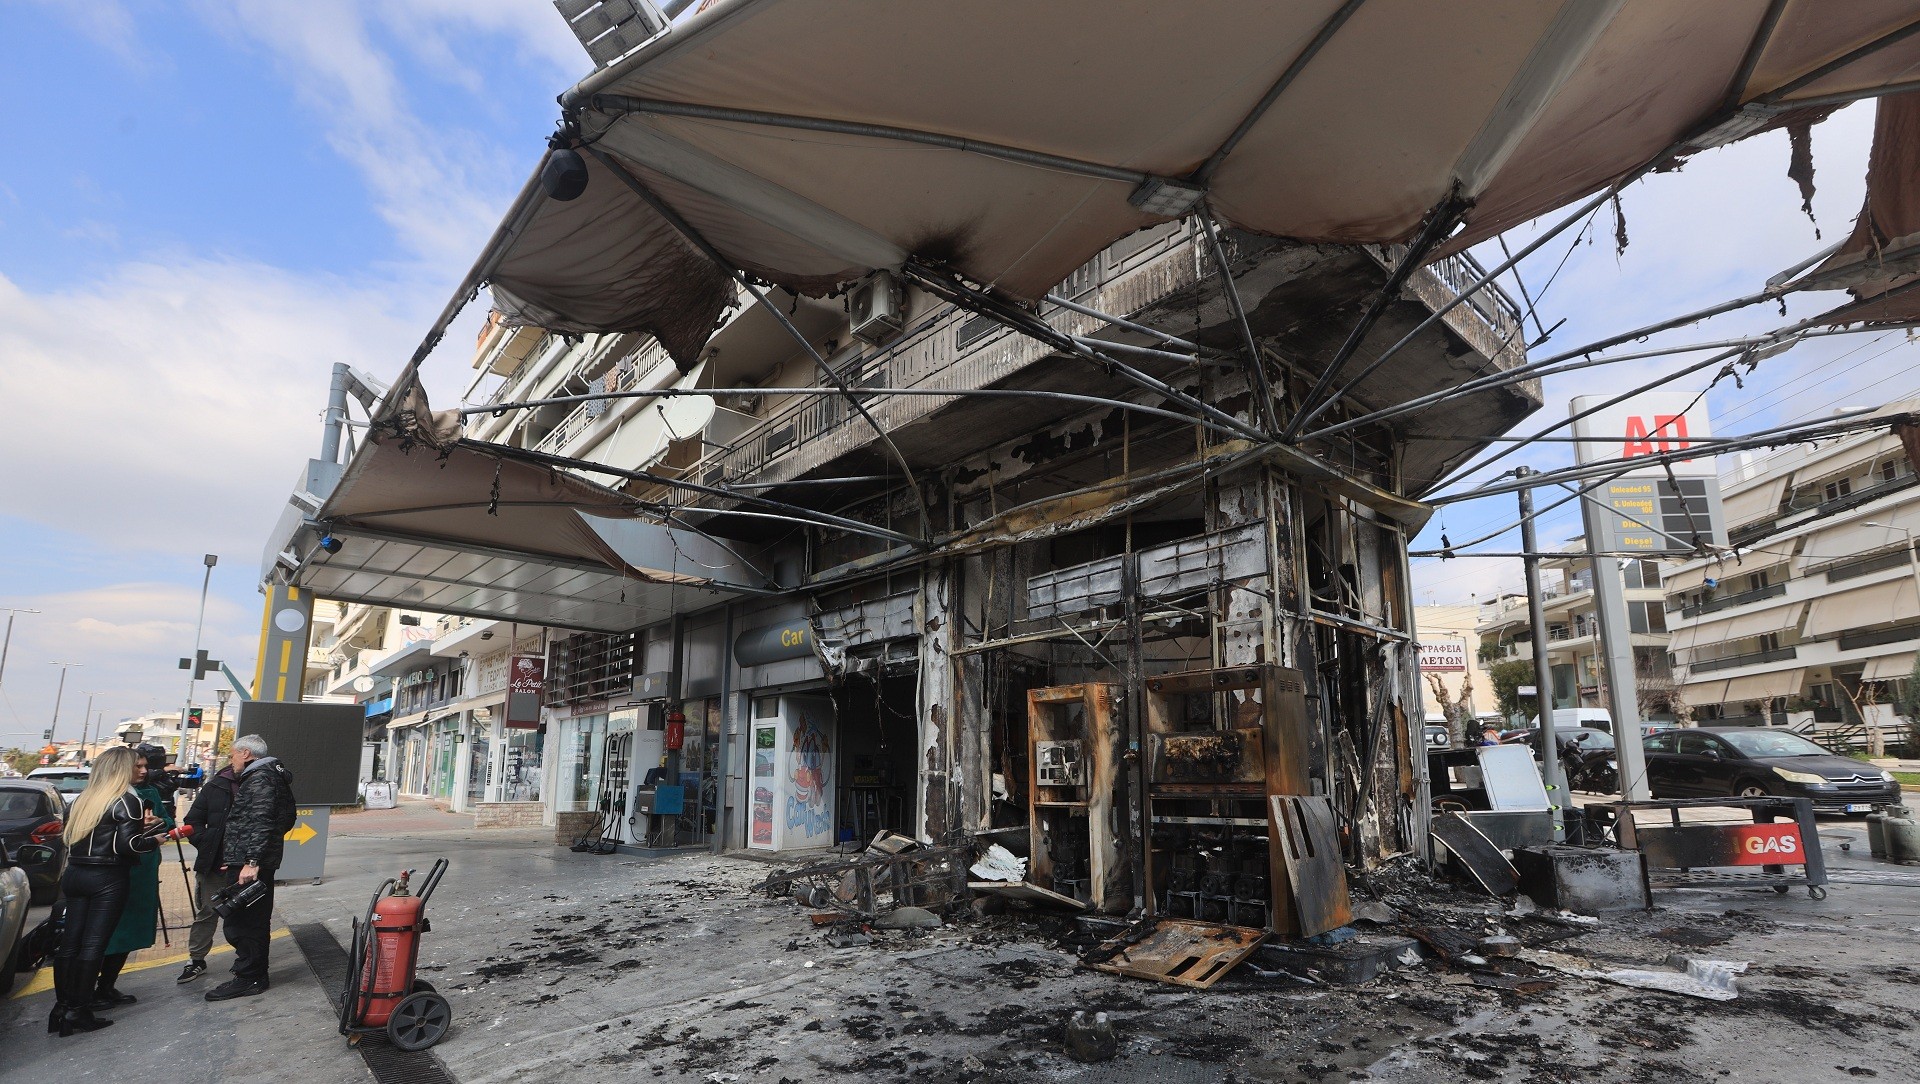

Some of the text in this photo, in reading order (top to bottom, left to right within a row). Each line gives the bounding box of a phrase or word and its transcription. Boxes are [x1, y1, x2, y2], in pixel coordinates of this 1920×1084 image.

[1610, 485, 1652, 494] Unleaded 95
[1621, 499, 1653, 507] Unleaded
[1641, 506, 1653, 514] 100
[1624, 537, 1653, 545] Diesel
[781, 629, 804, 647] Car
[1420, 656, 1463, 665] ΛΕΤΩΝ
[1745, 835, 1797, 854] GAS
